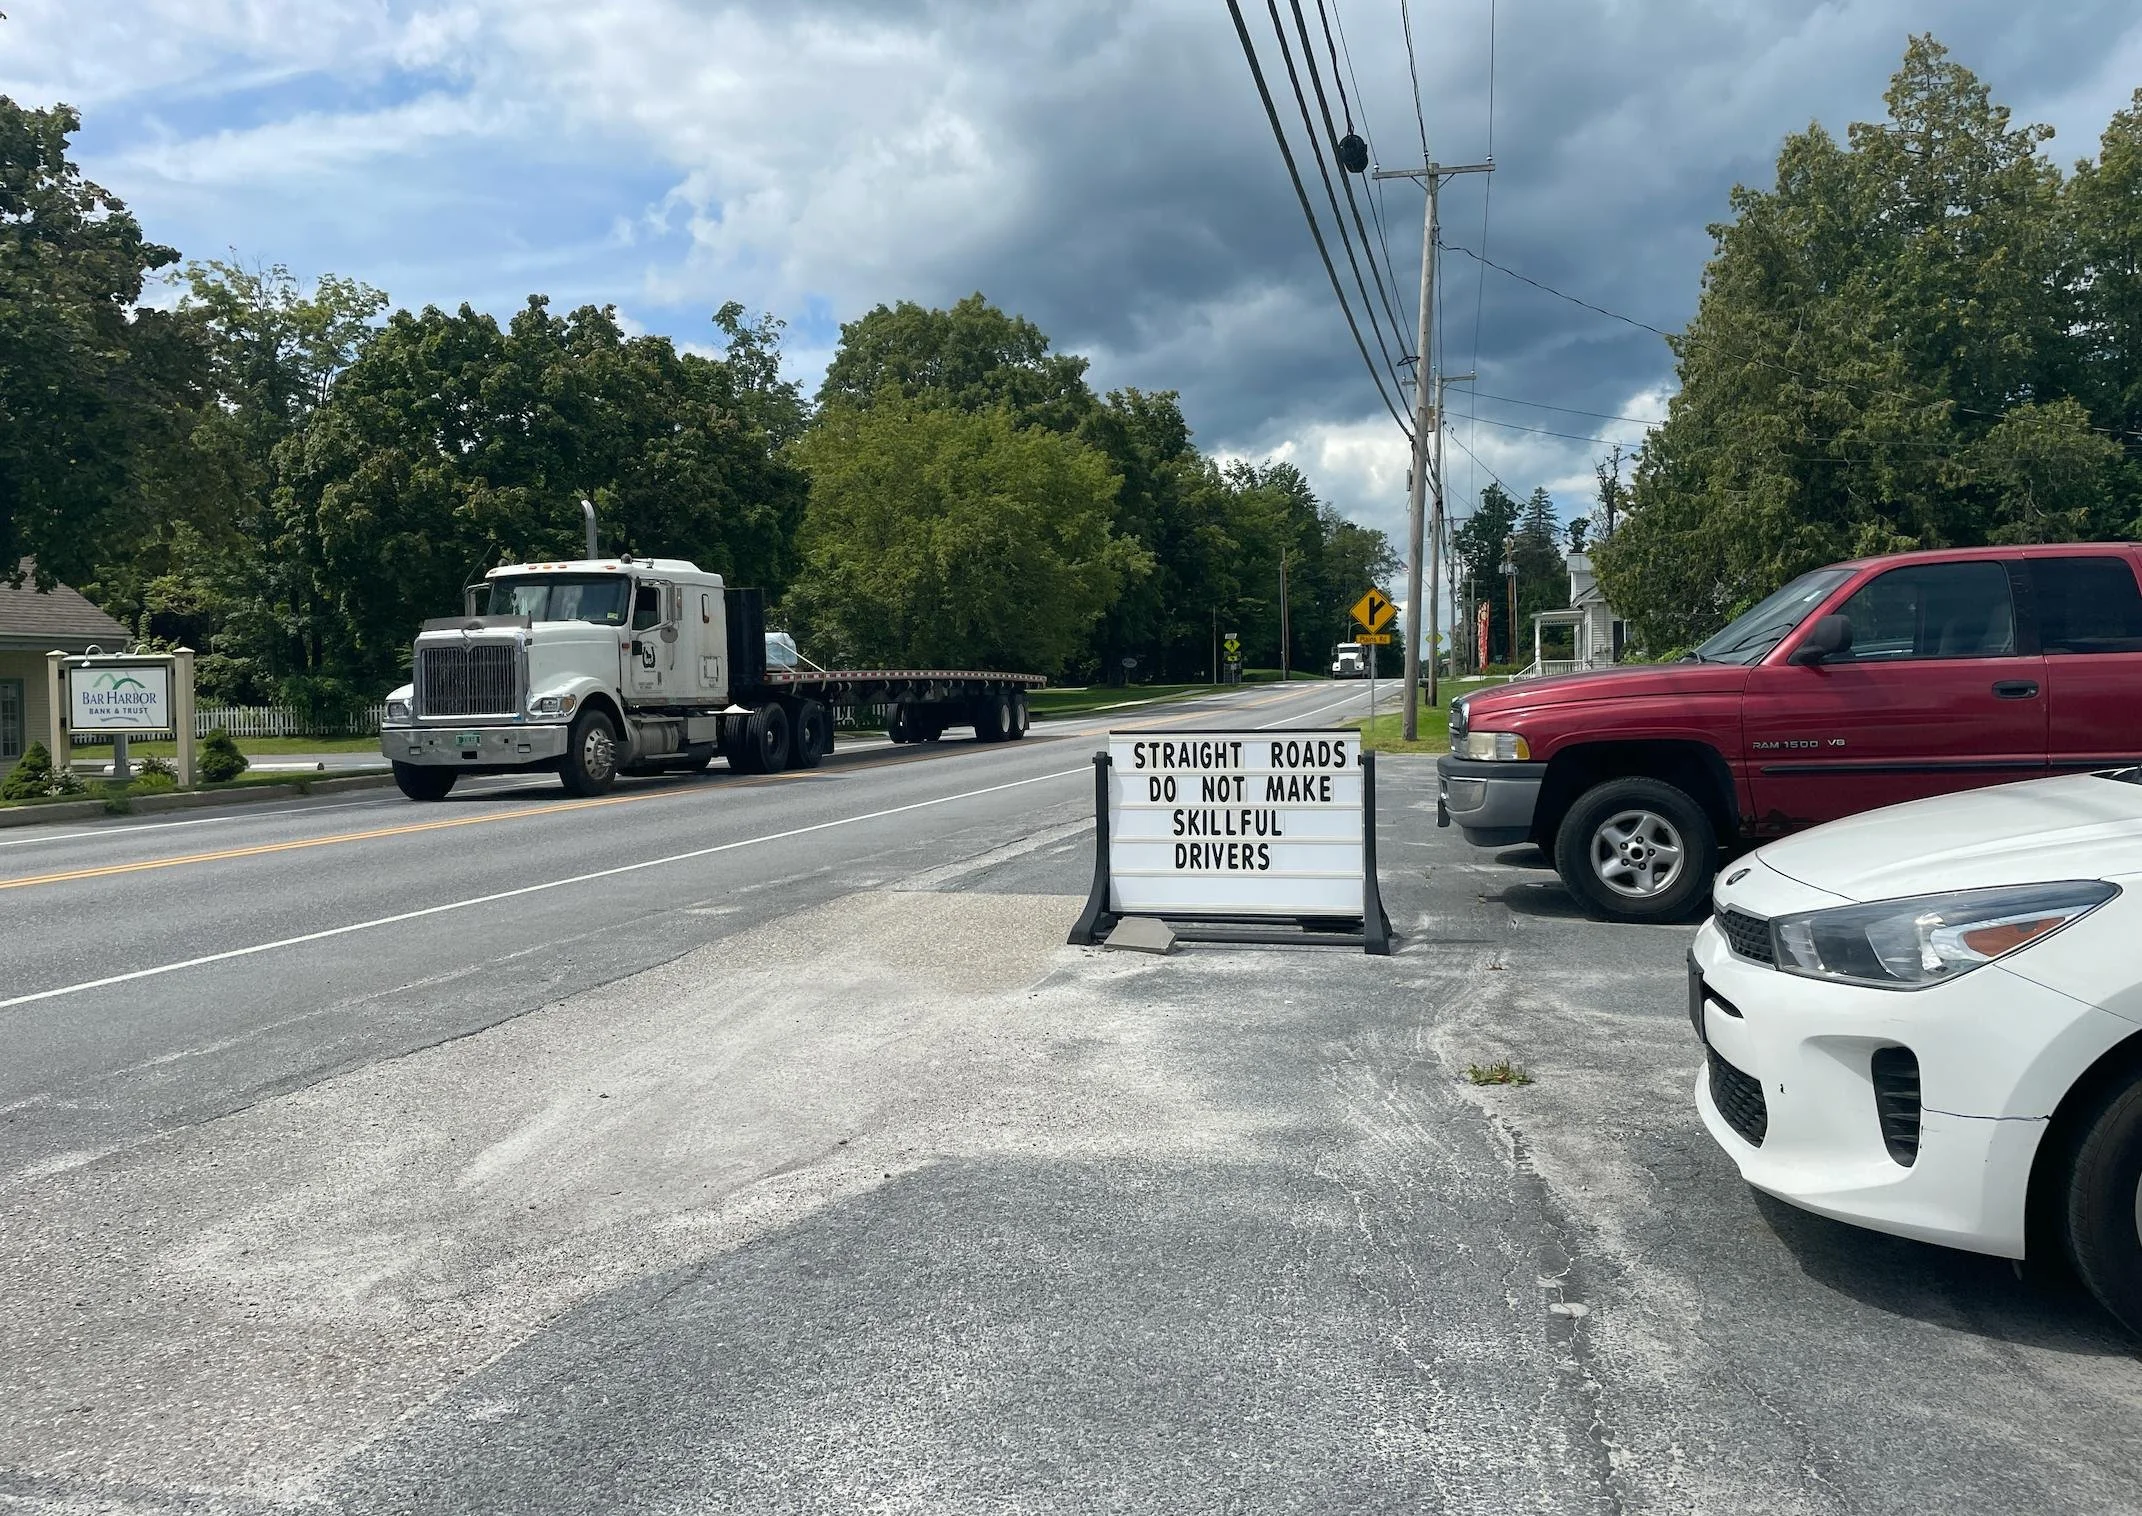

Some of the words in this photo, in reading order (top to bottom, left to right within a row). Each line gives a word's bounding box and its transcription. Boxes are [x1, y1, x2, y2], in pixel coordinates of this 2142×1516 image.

[82, 691, 104, 705] BAR
[107, 691, 157, 705] HARBOR
[89, 707, 111, 715] BANK
[1133, 741, 1242, 769] STRAIGHT
[1271, 740, 1347, 769] ROADS
[1752, 741, 1780, 750] RAM
[1784, 740, 1819, 749] 1500
[1149, 776, 1177, 803] DO
[1202, 775, 1245, 803] NOT
[1265, 774, 1331, 802] MAKE
[1173, 808, 1283, 836] SKILLFUL
[1175, 842, 1271, 871] DRIVERS
